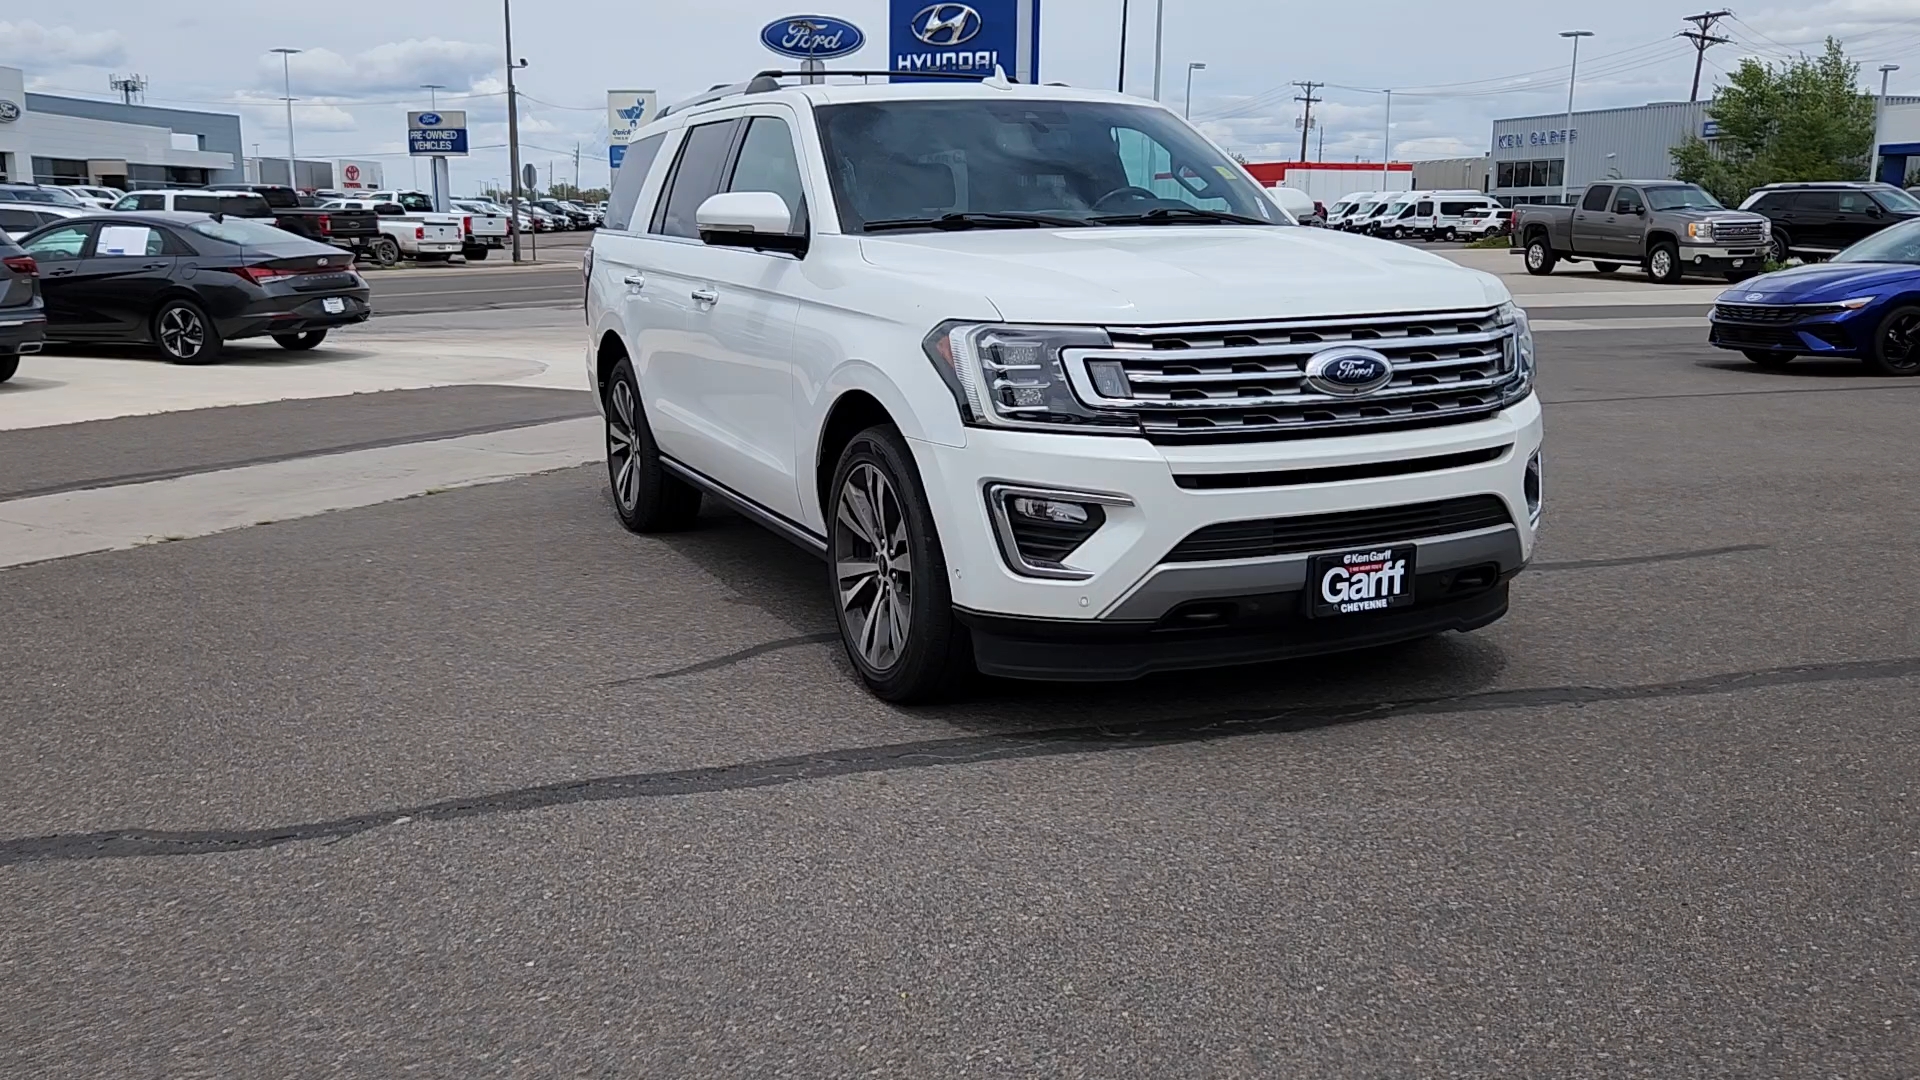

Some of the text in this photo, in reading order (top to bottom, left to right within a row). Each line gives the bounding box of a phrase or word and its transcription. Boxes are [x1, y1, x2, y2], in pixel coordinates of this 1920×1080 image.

[781, 20, 843, 49] Ford
[897, 51, 999, 72] HYUNDAI
[410, 130, 458, 140] PRE-OWNED
[612, 128, 632, 136] Quick
[1498, 128, 1578, 149] KEN GARFF
[414, 140, 452, 150] VEHICLES
[1336, 359, 1375, 379] Ford
[1351, 549, 1392, 564] Ken Garff
[1322, 559, 1406, 604] Garff
[1340, 598, 1388, 613] CHEYENNE
